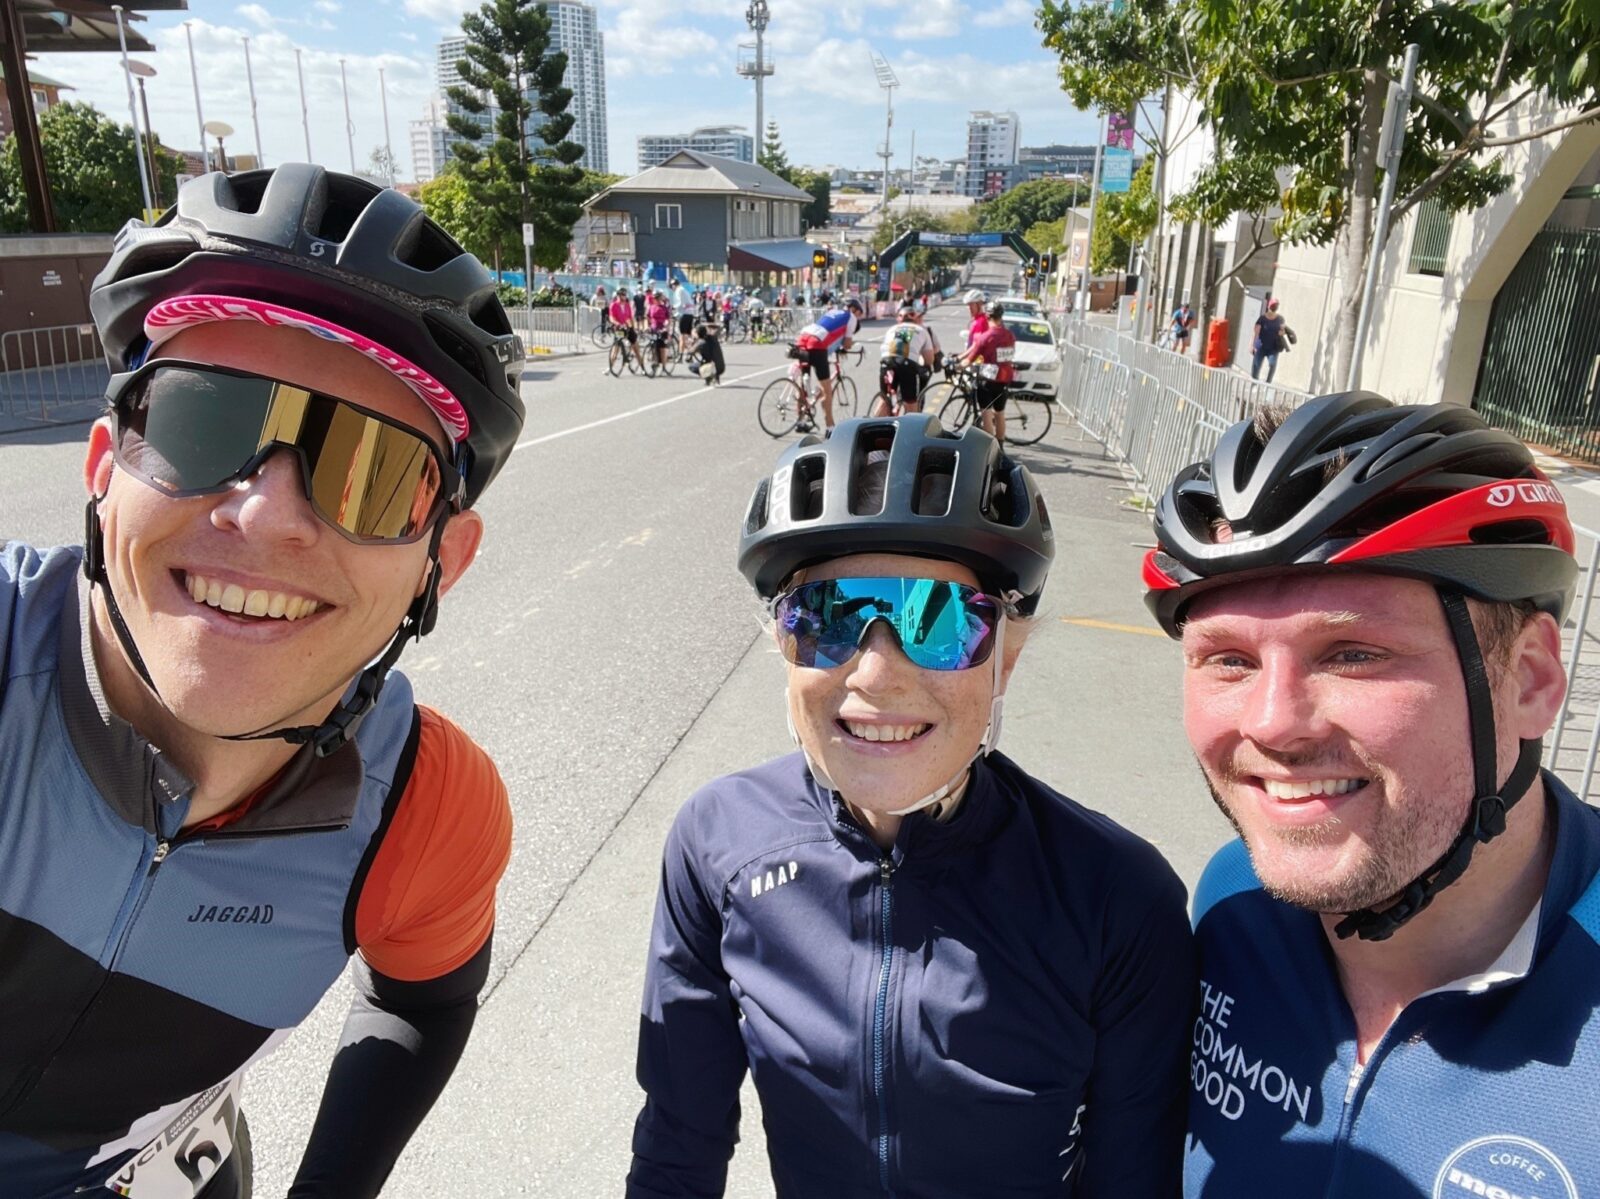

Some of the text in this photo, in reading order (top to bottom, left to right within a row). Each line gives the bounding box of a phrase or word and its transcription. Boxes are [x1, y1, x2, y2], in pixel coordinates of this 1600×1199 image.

[752, 861, 798, 898] MAAP
[187, 905, 273, 924] JAGGAD
[1200, 979, 1235, 1029] THE
[1190, 1050, 1246, 1120] GOOD
[1193, 1016, 1312, 1122] COMMON
[117, 1141, 162, 1184] UCI
[1489, 1153, 1546, 1182] COFFEE
